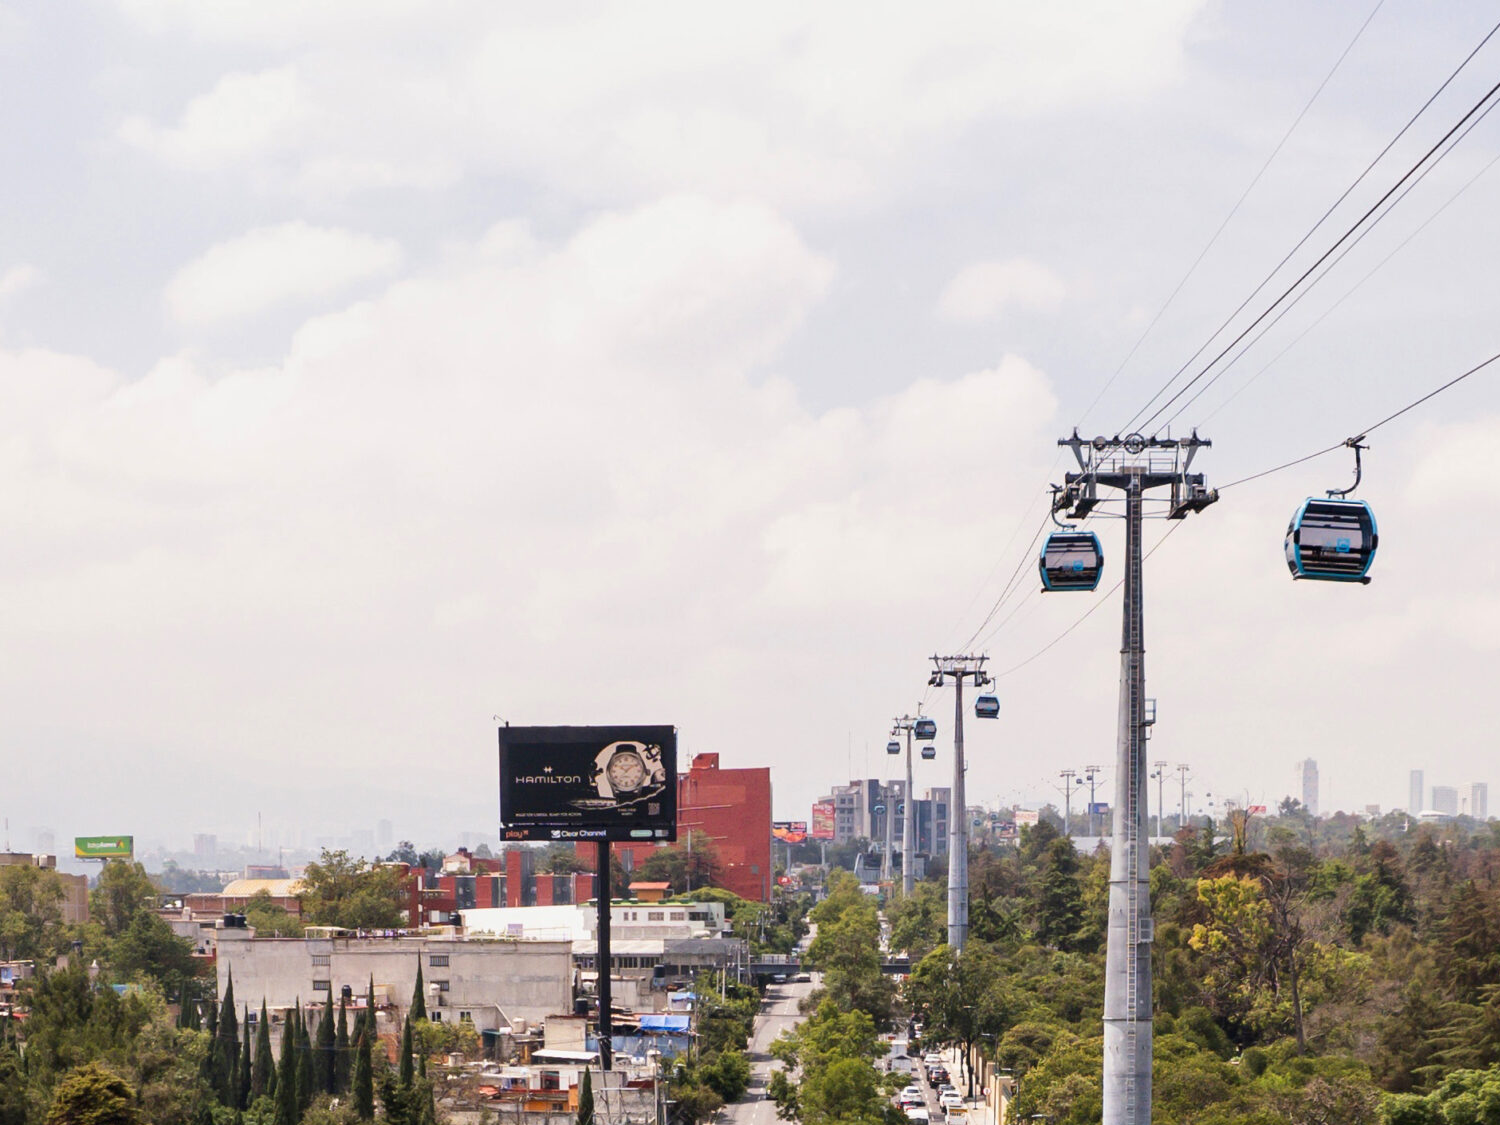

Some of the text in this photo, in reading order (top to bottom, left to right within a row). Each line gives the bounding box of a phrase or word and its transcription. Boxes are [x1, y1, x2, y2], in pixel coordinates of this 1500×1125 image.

[515, 775, 581, 784] HAMILTON
[561, 829, 606, 838] Clear Channel
